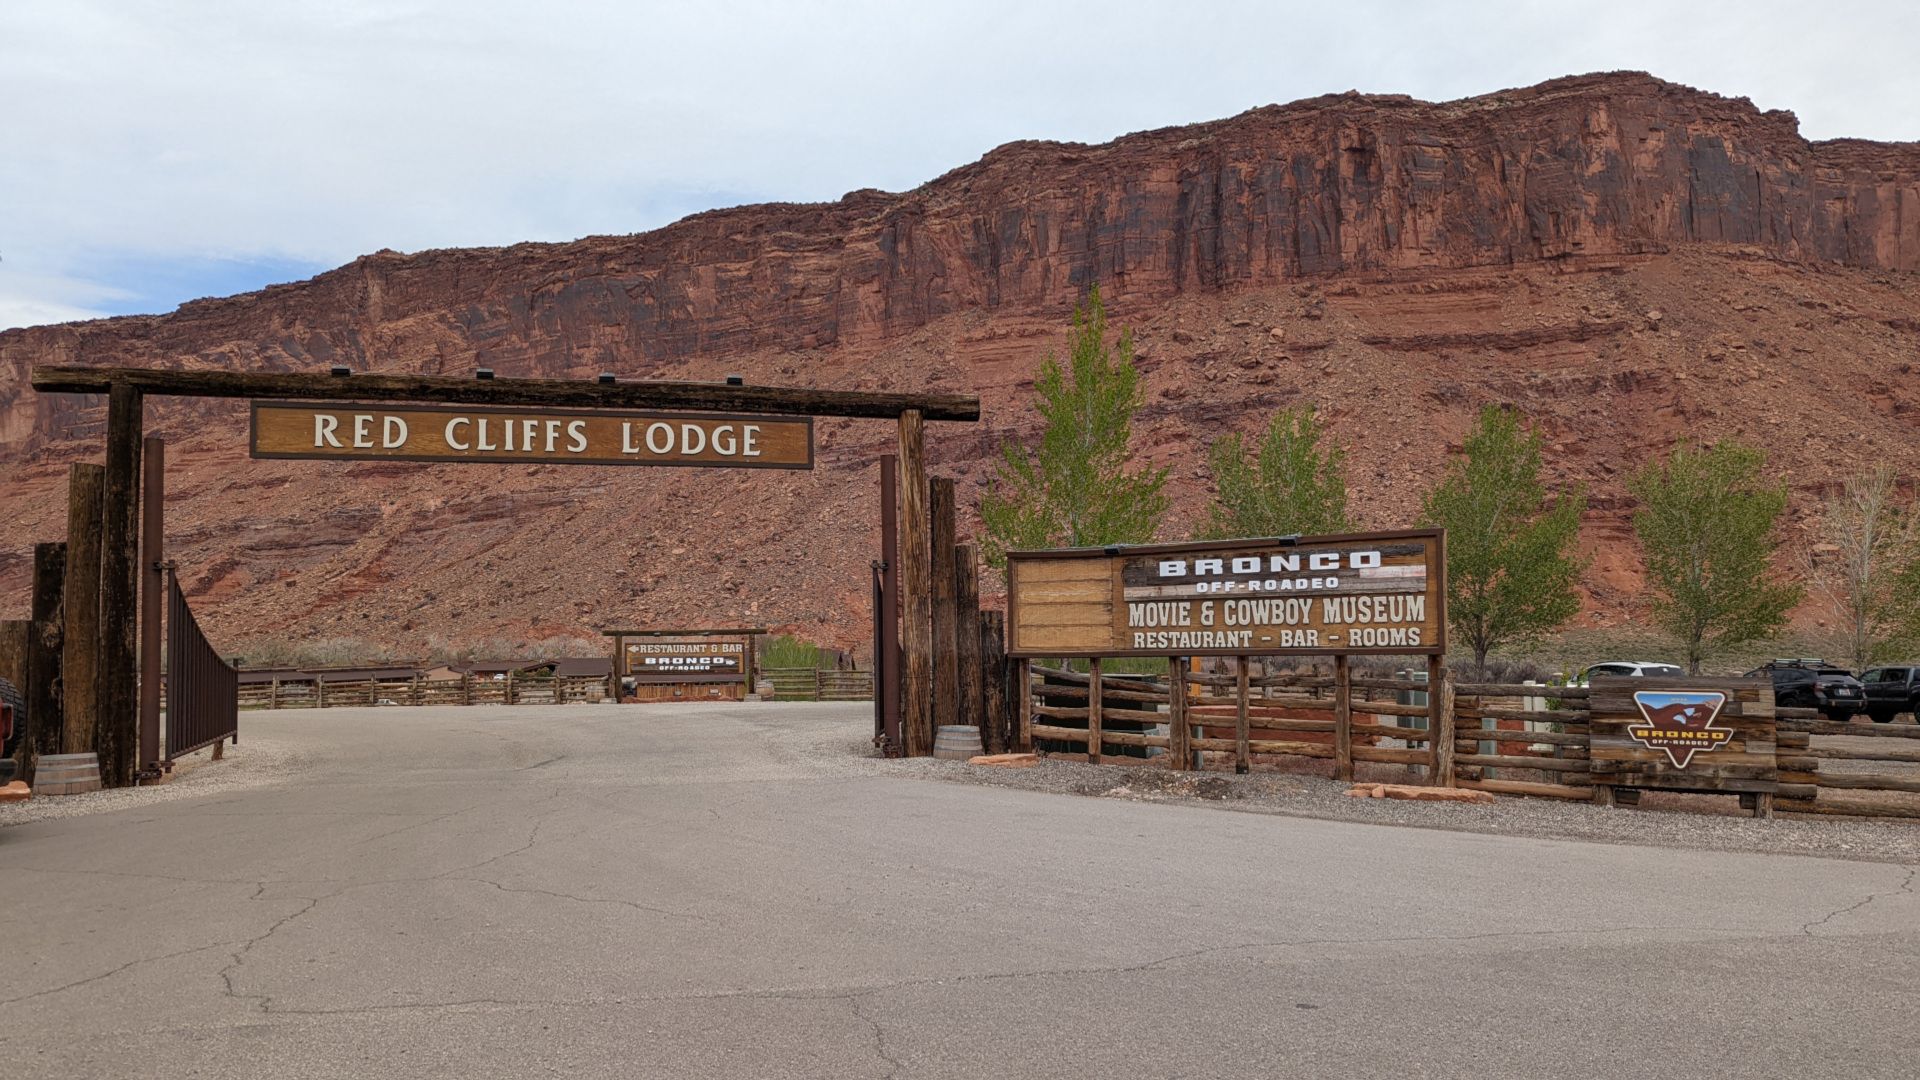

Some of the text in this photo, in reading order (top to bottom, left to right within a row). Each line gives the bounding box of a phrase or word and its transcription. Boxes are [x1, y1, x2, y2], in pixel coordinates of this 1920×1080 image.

[314, 414, 762, 456] RED CLIFFS LODGE
[1159, 551, 1381, 577] BRONCO
[1196, 577, 1339, 593] OFF-ROADEO
[1128, 595, 1425, 627] MOVIE & COWBOY MUSEUM
[1134, 630, 1252, 649] RESTAURANT
[1280, 629, 1319, 648] BAR
[1349, 627, 1421, 646] ROOMS
[640, 644, 743, 653] RESTAURANT & BAR
[645, 657, 724, 665] BRONCO
[1637, 729, 1724, 739] BRONCO
